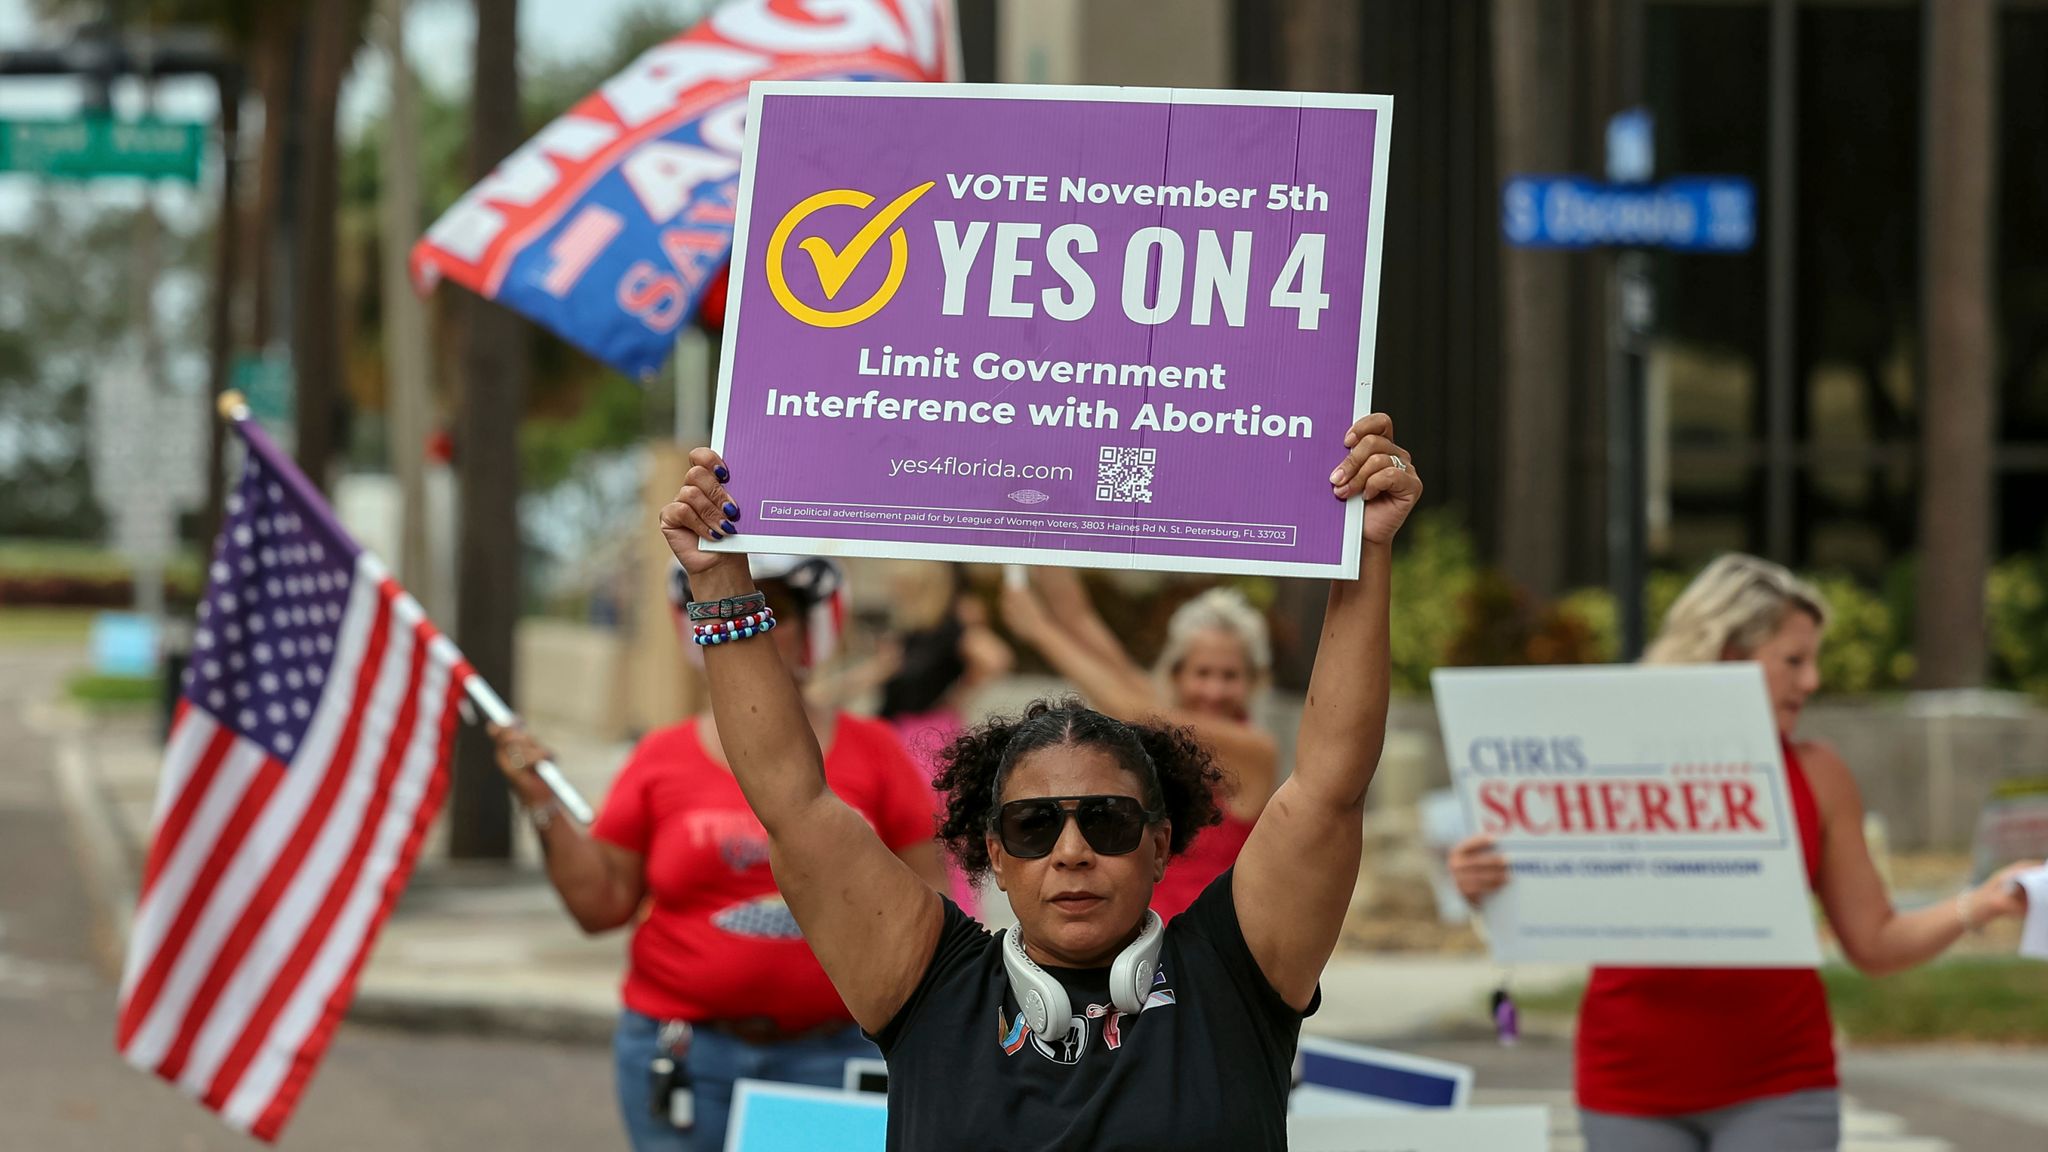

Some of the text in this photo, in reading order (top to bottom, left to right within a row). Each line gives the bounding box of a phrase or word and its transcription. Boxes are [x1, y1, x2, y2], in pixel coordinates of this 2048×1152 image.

[945, 173, 1329, 212] VOTE November 5th
[933, 219, 1330, 331] YES ON 4
[858, 345, 1227, 391] Limit Government
[765, 388, 1313, 439] Interference with Abortion
[888, 456, 1073, 481] yes4florida.com
[770, 506, 1287, 540] Paid political advertisement paid for by League of Women Voters, 3803 Haines Rd N. St. Petersburg, FL 33703
[1467, 736, 1588, 775] CHRIS
[1478, 779, 1767, 834] SCHERER
